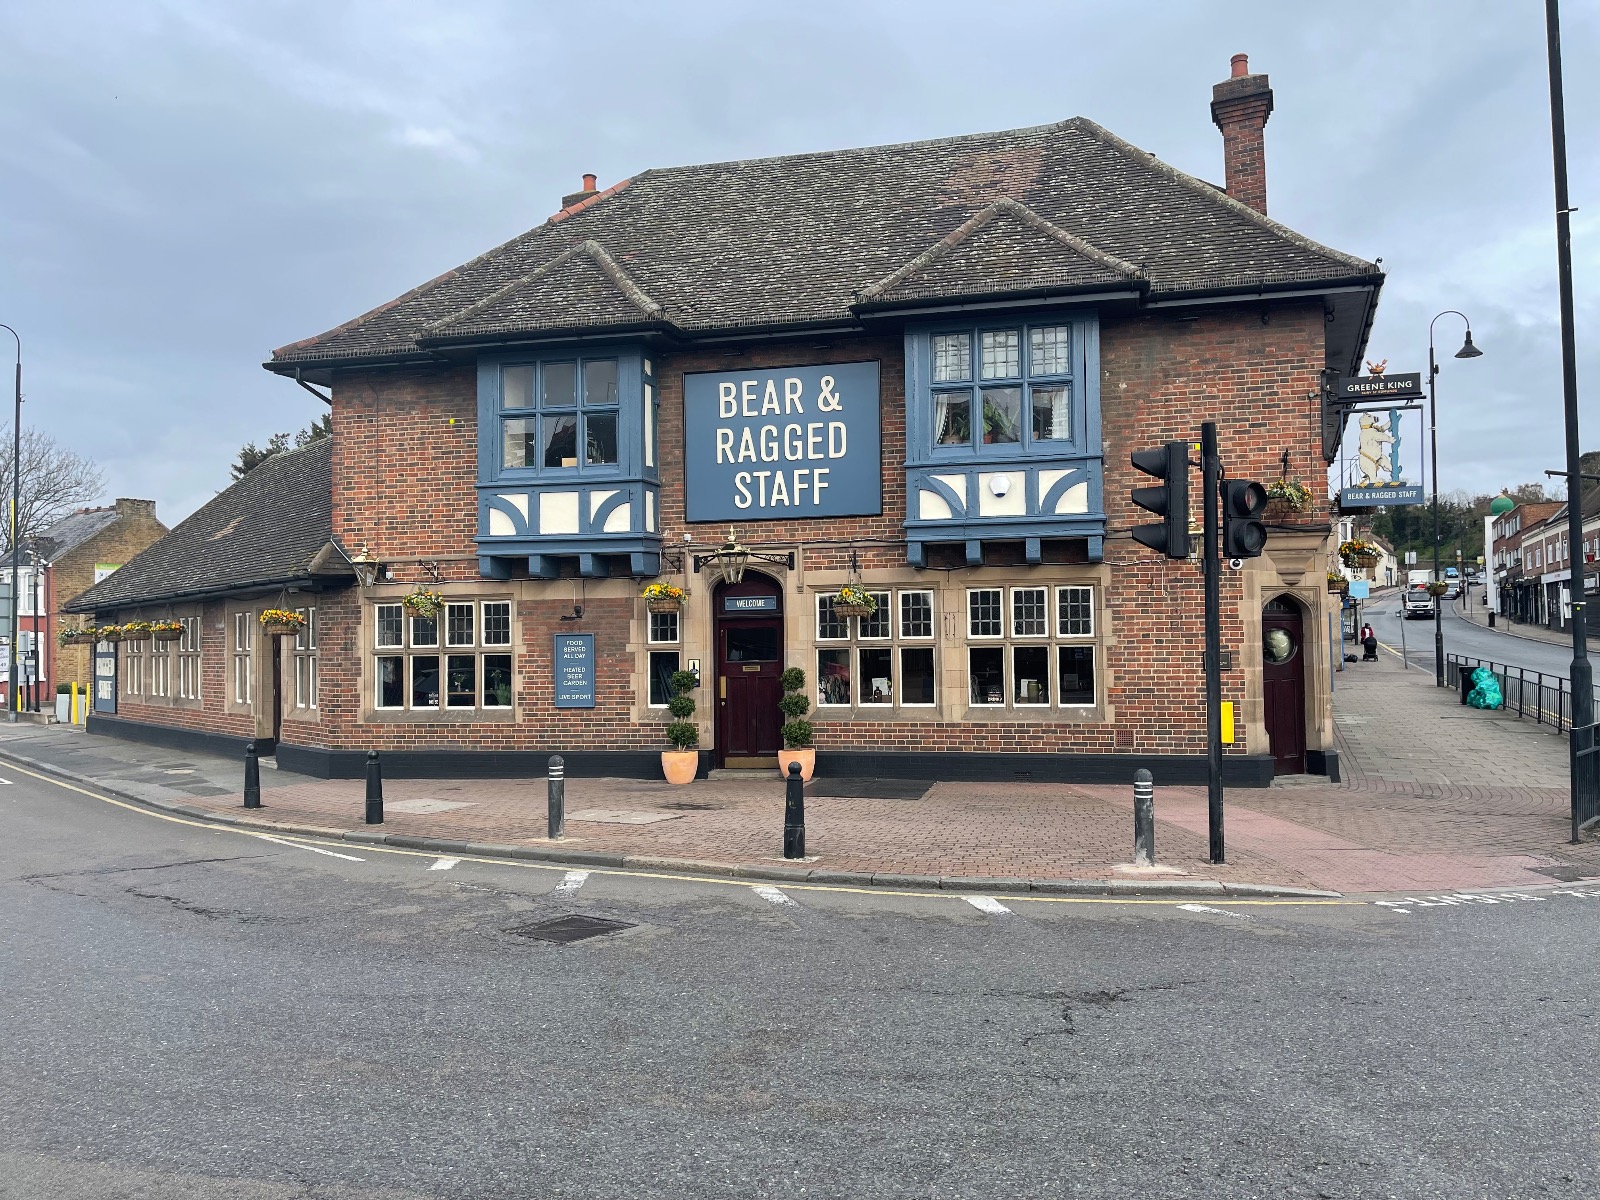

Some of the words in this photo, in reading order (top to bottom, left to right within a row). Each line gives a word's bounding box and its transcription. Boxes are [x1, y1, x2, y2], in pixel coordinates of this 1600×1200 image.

[719, 379, 804, 418] BEAR
[817, 375, 843, 412] &
[1347, 382, 1385, 392] GREENE
[1387, 380, 1412, 389] KING
[716, 421, 847, 464] RAGGED
[734, 468, 830, 509] STAFF
[1398, 490, 1417, 498] STAFF
[736, 599, 766, 608] WELCOME
